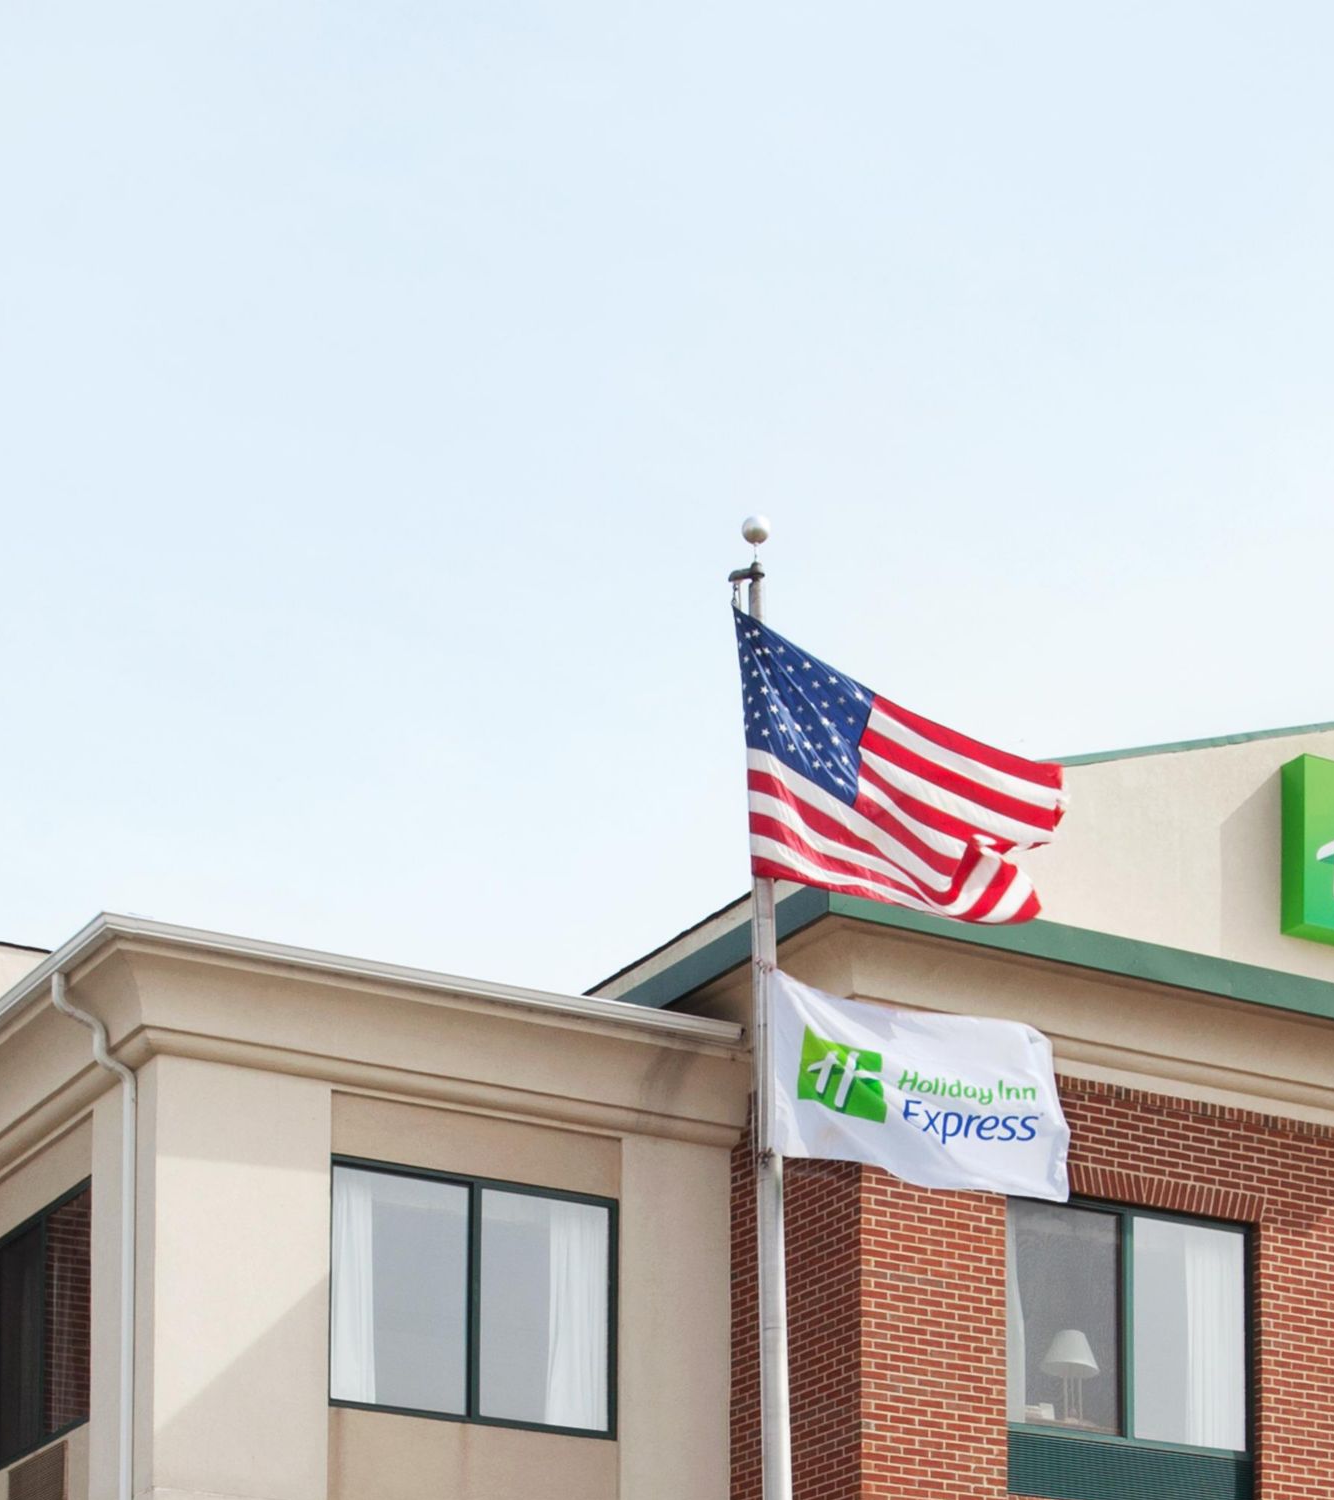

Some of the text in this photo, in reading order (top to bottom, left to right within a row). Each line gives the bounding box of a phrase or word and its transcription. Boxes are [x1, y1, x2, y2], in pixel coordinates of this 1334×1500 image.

[898, 1070, 1037, 1105] Holiday Inn
[903, 1099, 1039, 1145] Express
